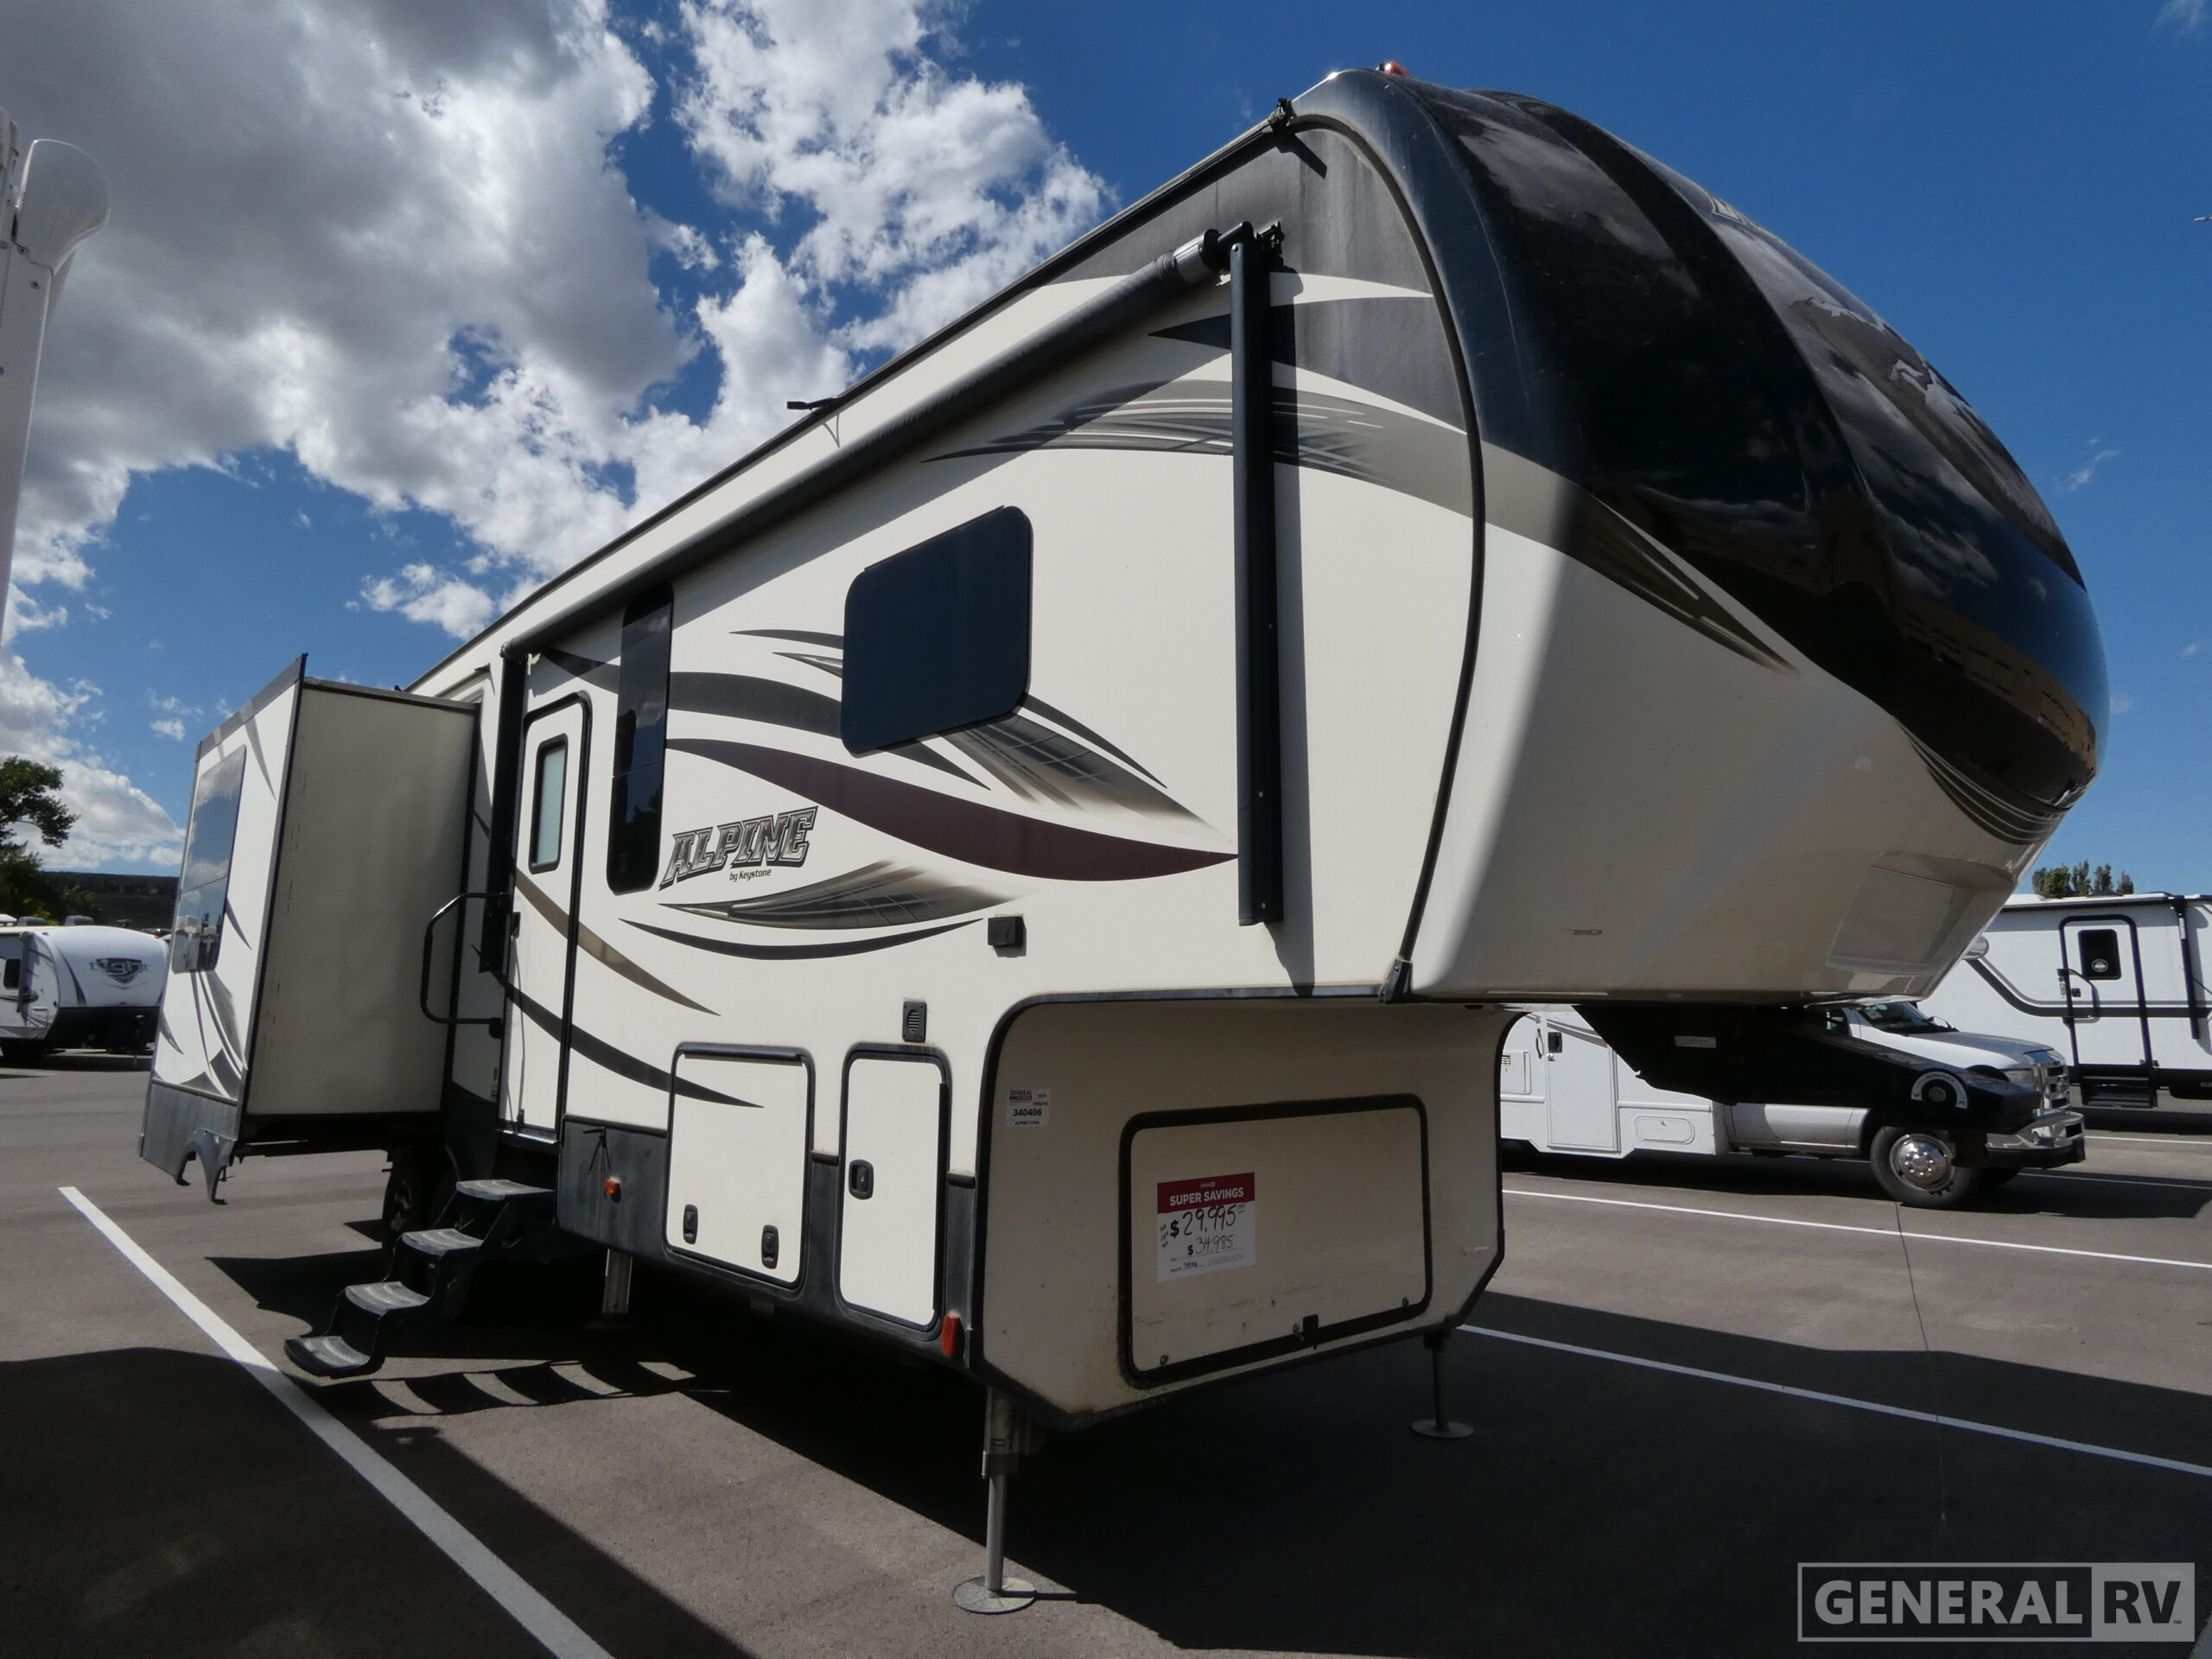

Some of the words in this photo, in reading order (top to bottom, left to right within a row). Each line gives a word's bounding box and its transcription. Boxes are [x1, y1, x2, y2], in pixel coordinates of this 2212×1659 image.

[658, 805, 819, 892] ALPINE
[729, 872, 738, 882] by
[739, 868, 772, 880] Keystone
[1170, 1193, 1202, 1206] SUPER
[1204, 1187, 1244, 1201] SAVINGS
